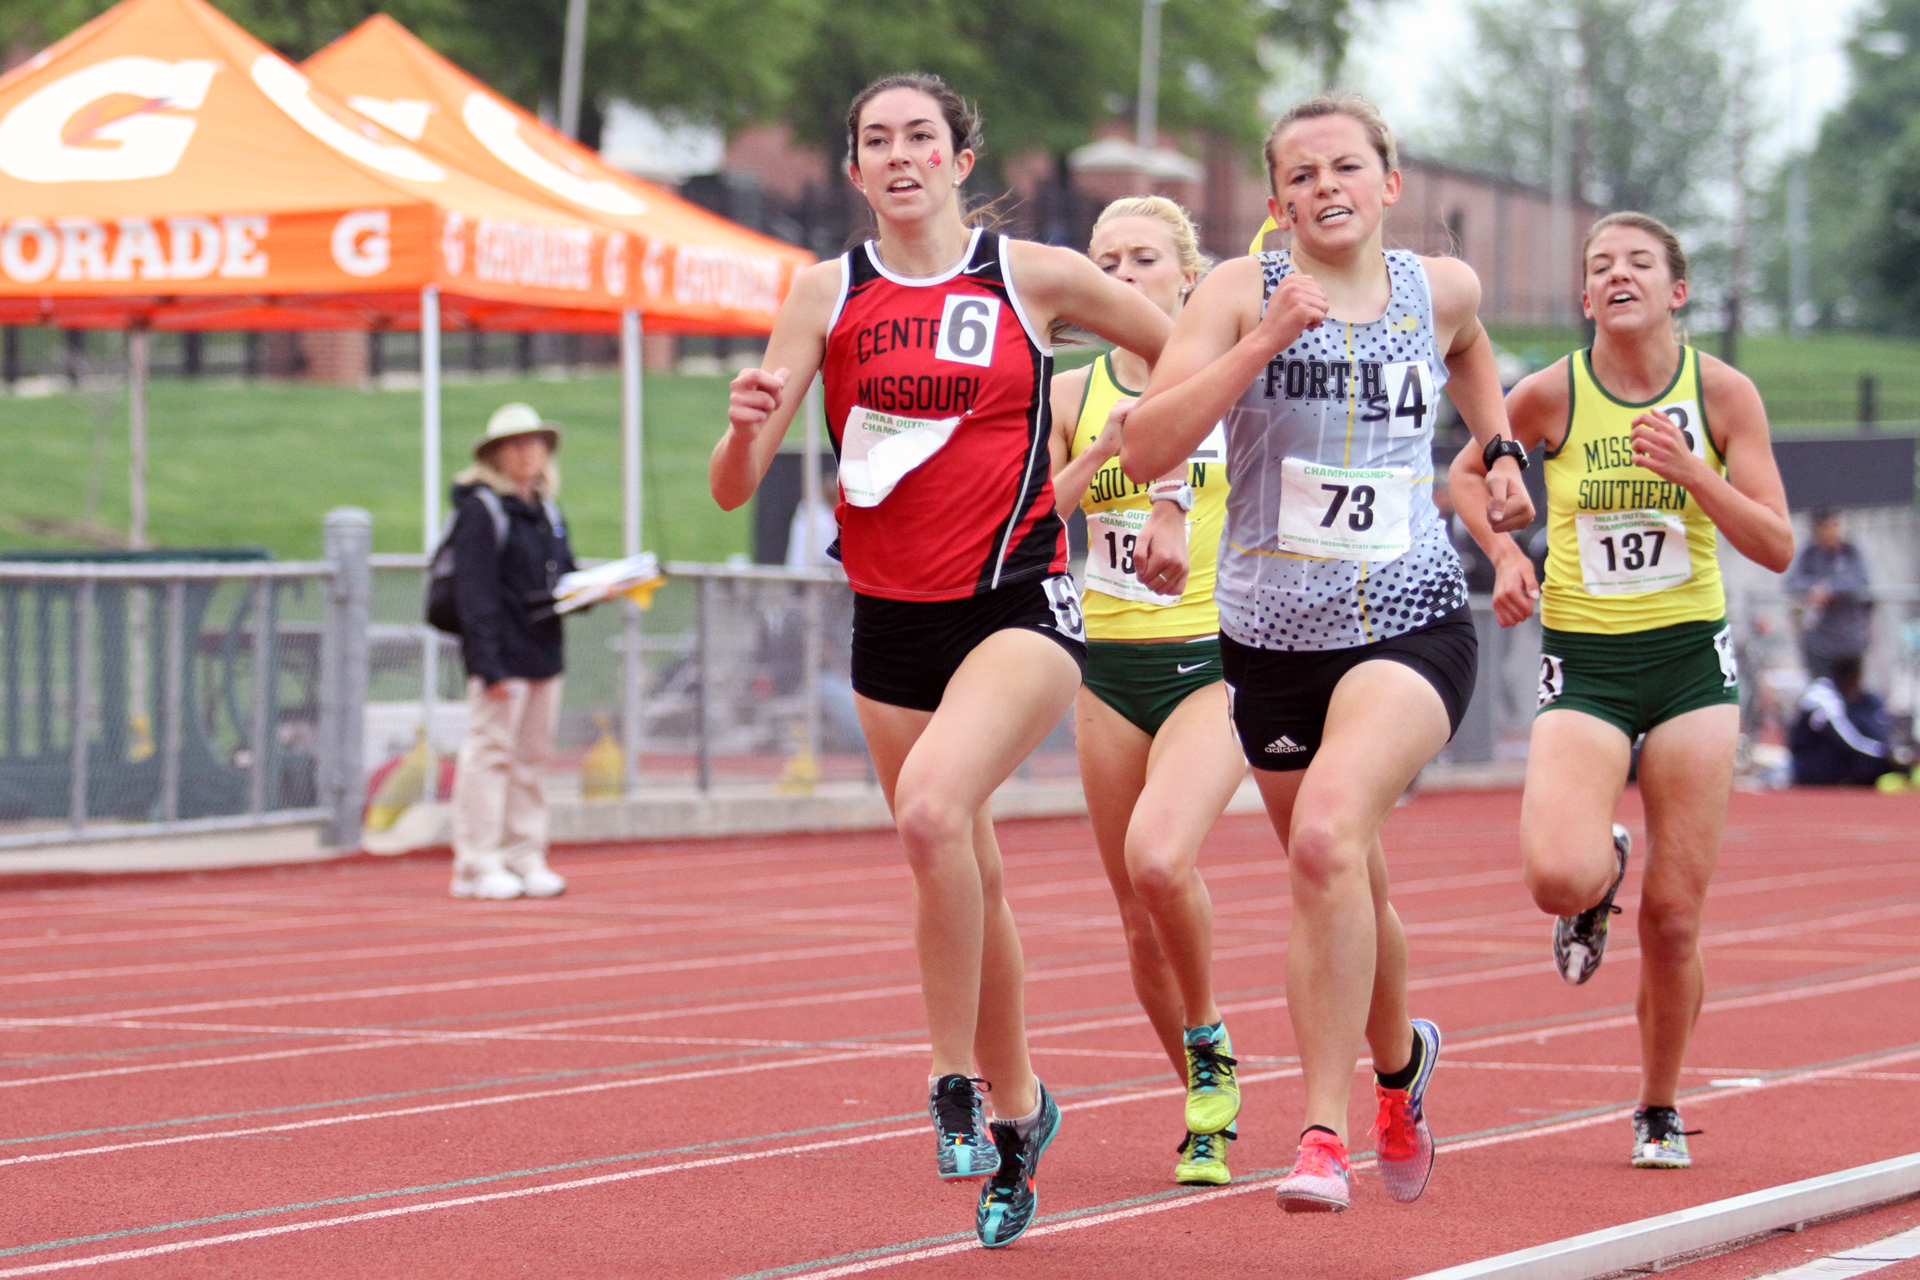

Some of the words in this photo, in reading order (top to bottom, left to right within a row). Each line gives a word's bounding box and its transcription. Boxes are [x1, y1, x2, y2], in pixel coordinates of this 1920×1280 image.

[1, 215, 269, 283] ORADE
[330, 208, 391, 278] G
[947, 300, 990, 358] 6
[858, 376, 979, 412] MISSOURI
[1263, 359, 1351, 400] FORT
[1395, 365, 1427, 430] 4
[865, 412, 893, 425] MIAA
[1303, 466, 1394, 479] CHAMPIONSHIPS
[1319, 483, 1376, 532] 73
[1578, 479, 1687, 510] SOUTHERN
[1600, 530, 1667, 572] 137
[1264, 745, 1307, 753] adidas
